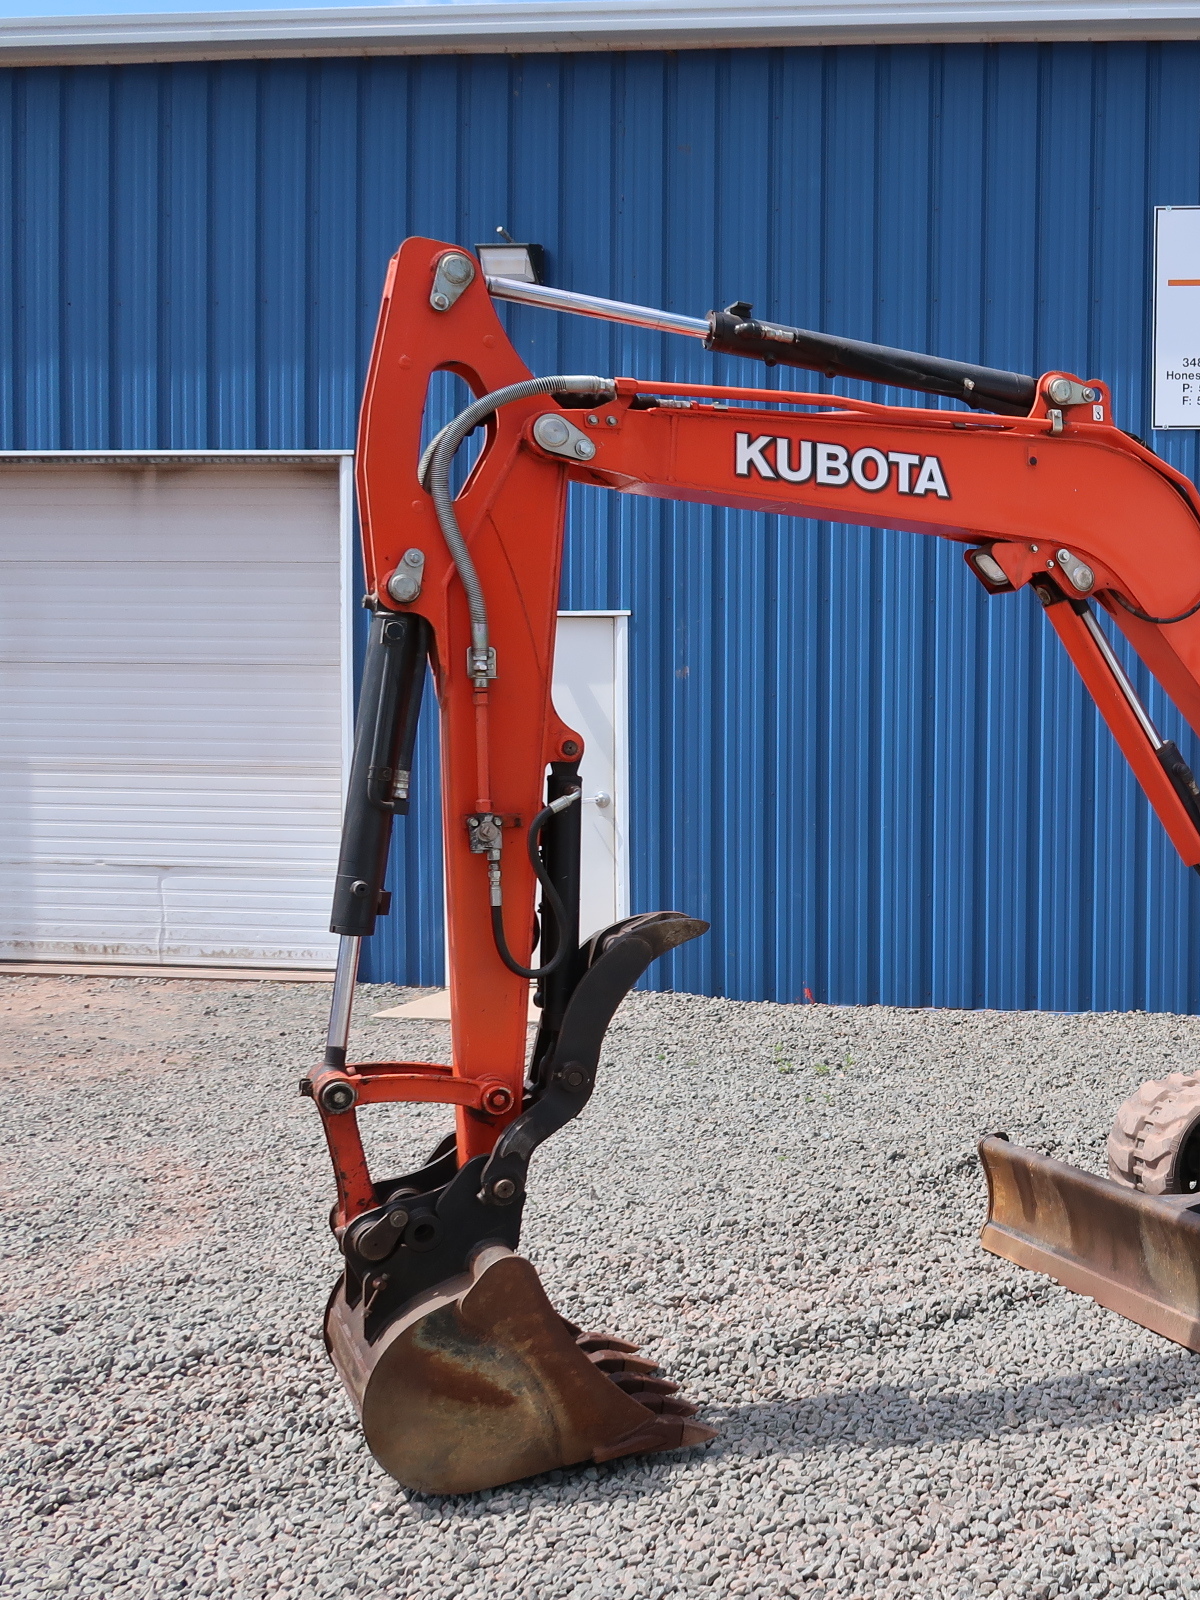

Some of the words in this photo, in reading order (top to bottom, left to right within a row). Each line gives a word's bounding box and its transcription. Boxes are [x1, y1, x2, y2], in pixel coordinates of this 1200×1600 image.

[1182, 383, 1192, 393] P:
[1182, 396, 1192, 406] F:
[735, 432, 951, 498] KUBOTA
